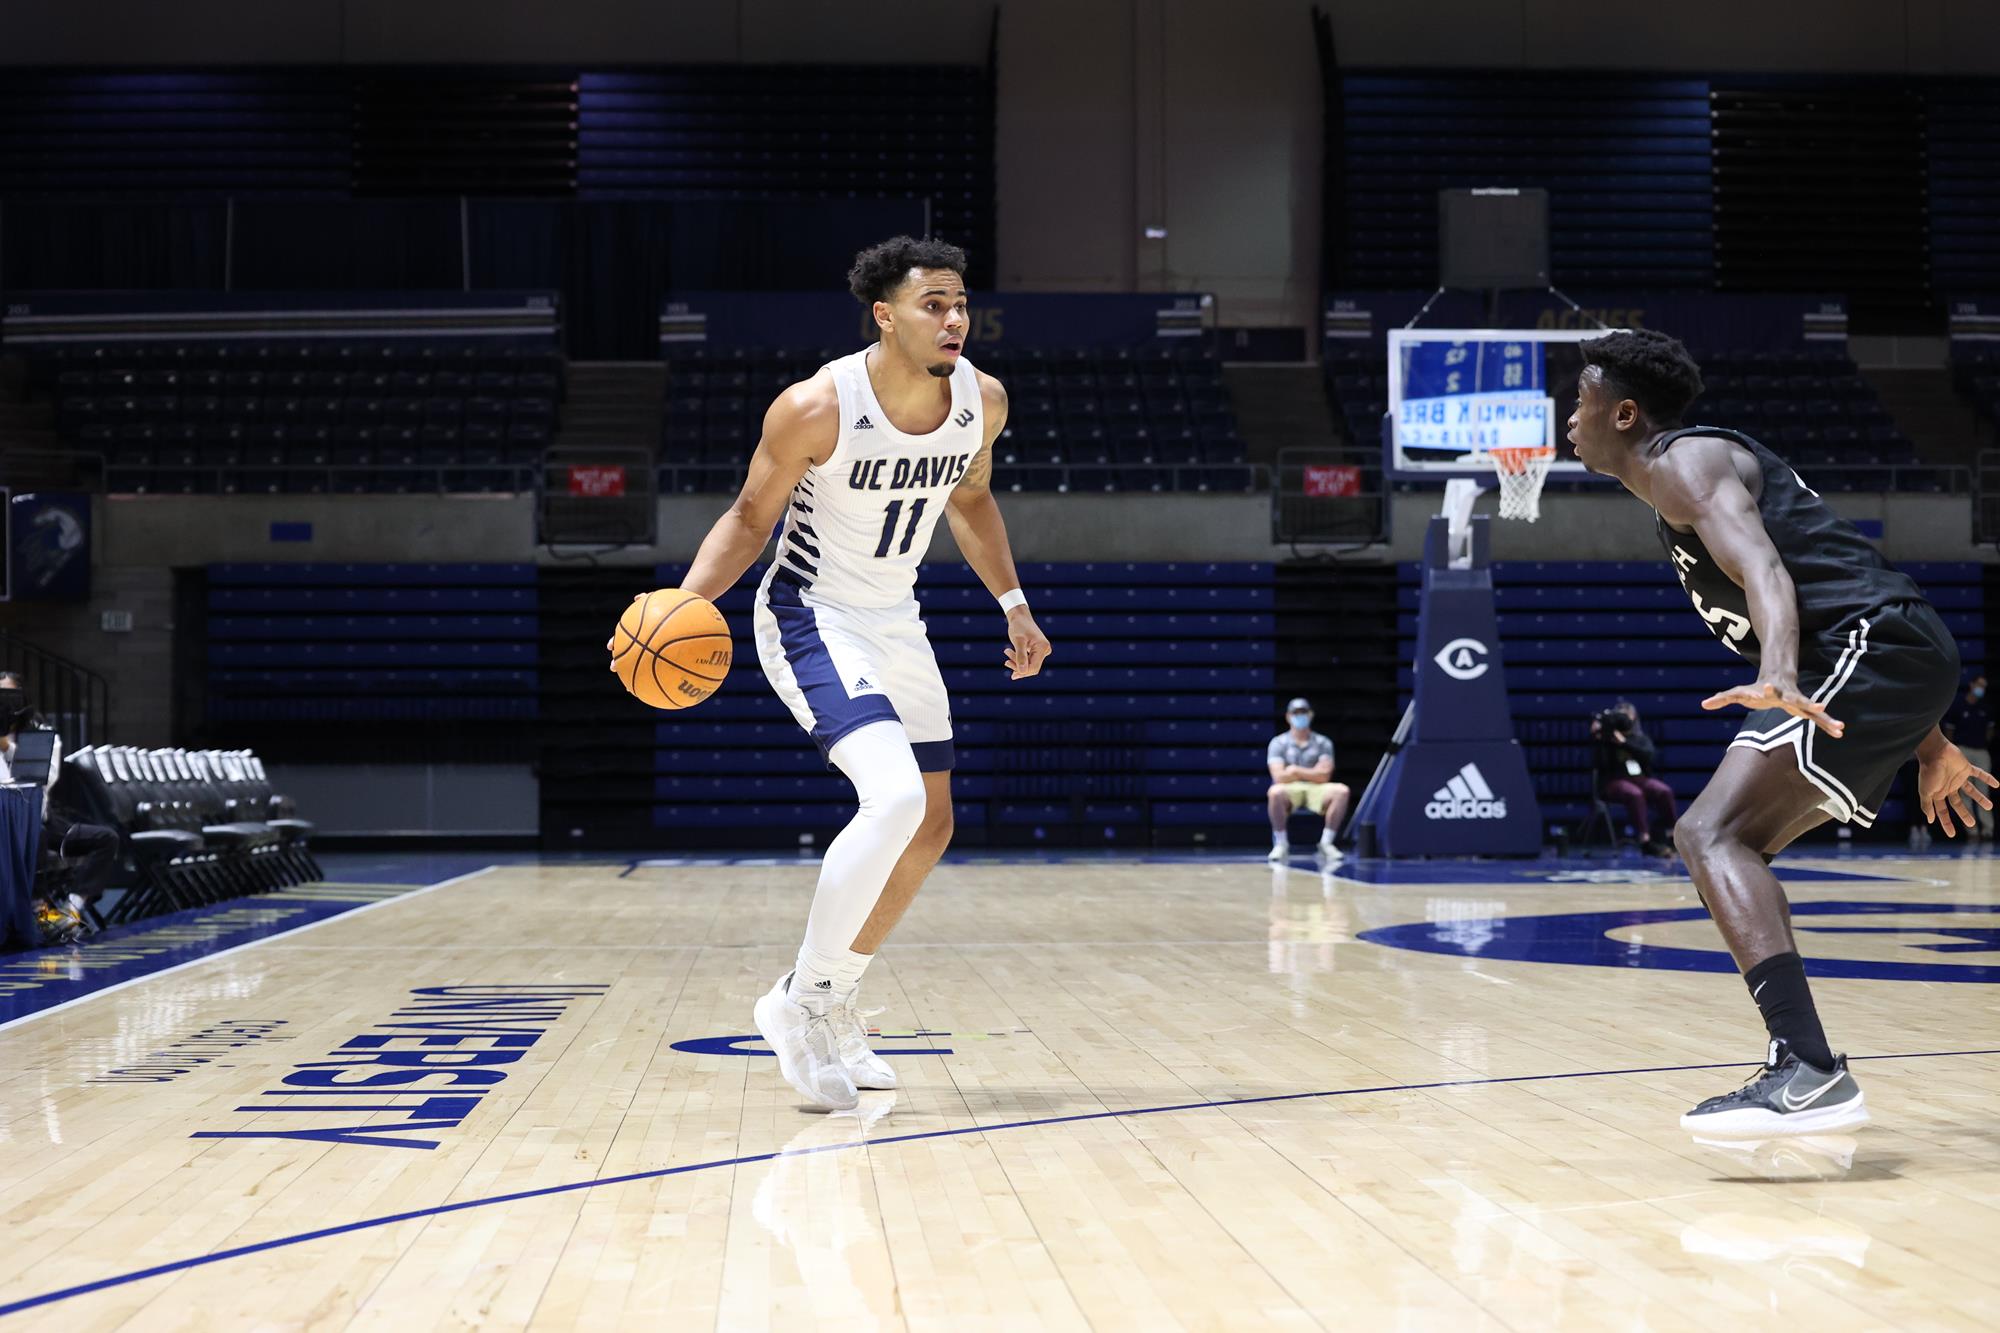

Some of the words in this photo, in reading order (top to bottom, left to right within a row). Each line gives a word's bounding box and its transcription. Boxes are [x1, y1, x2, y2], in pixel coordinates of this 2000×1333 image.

[848, 459, 887, 490] UC
[889, 453, 970, 490] DAVIS
[874, 498, 928, 557] 11
[1691, 589, 1751, 655] 5
[1425, 799, 1507, 819] adidas
[189, 984, 610, 1150] UNIVERSITY
